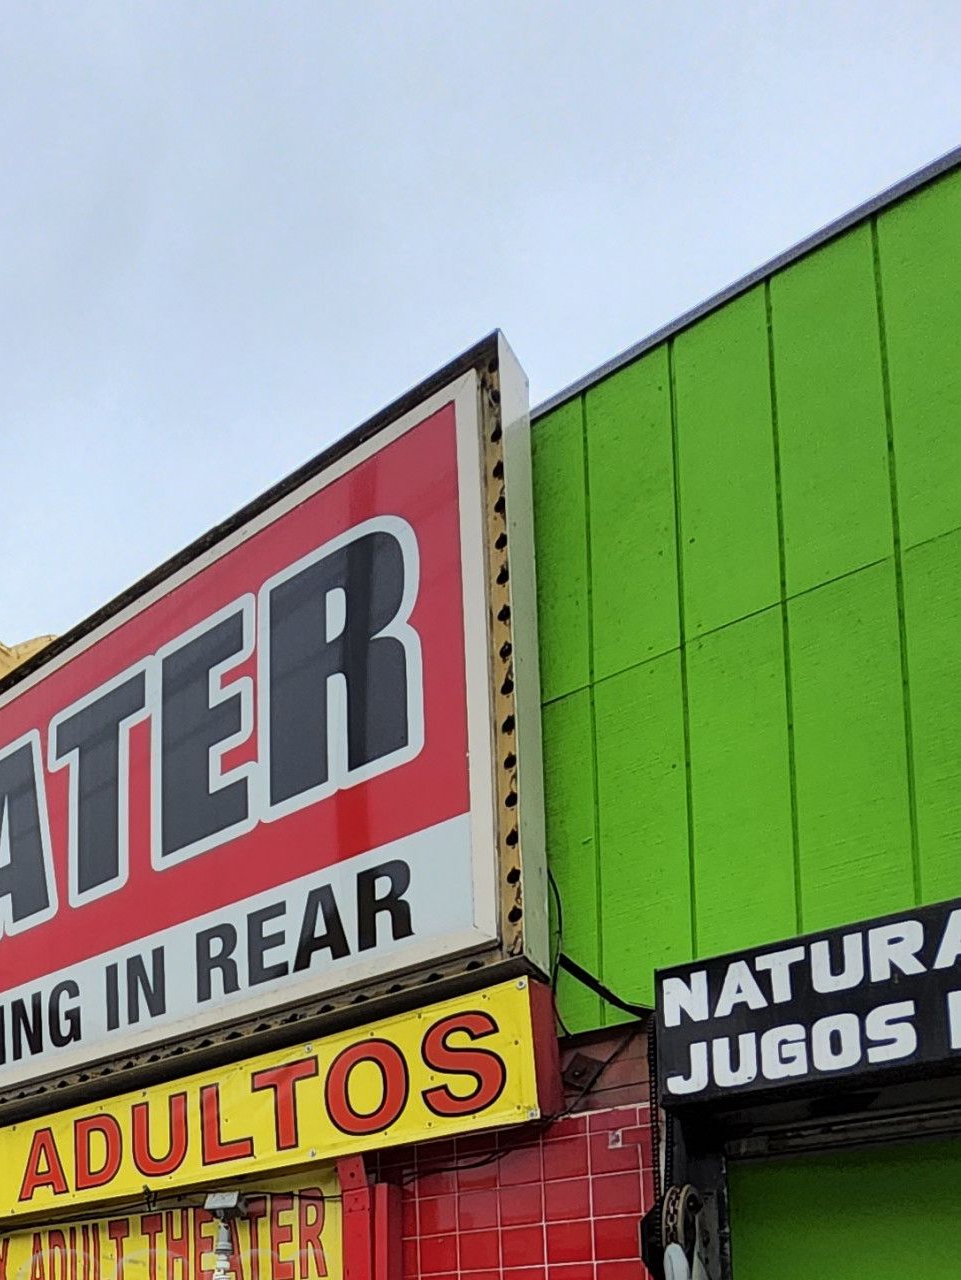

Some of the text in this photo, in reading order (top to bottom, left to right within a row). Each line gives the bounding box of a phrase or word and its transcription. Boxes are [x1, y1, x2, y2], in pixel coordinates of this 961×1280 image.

[105, 945, 167, 1032] IN
[195, 858, 416, 1004] REAR
[18, 1009, 507, 1202] ADULTOS
[666, 999, 918, 1096] JUGOS
